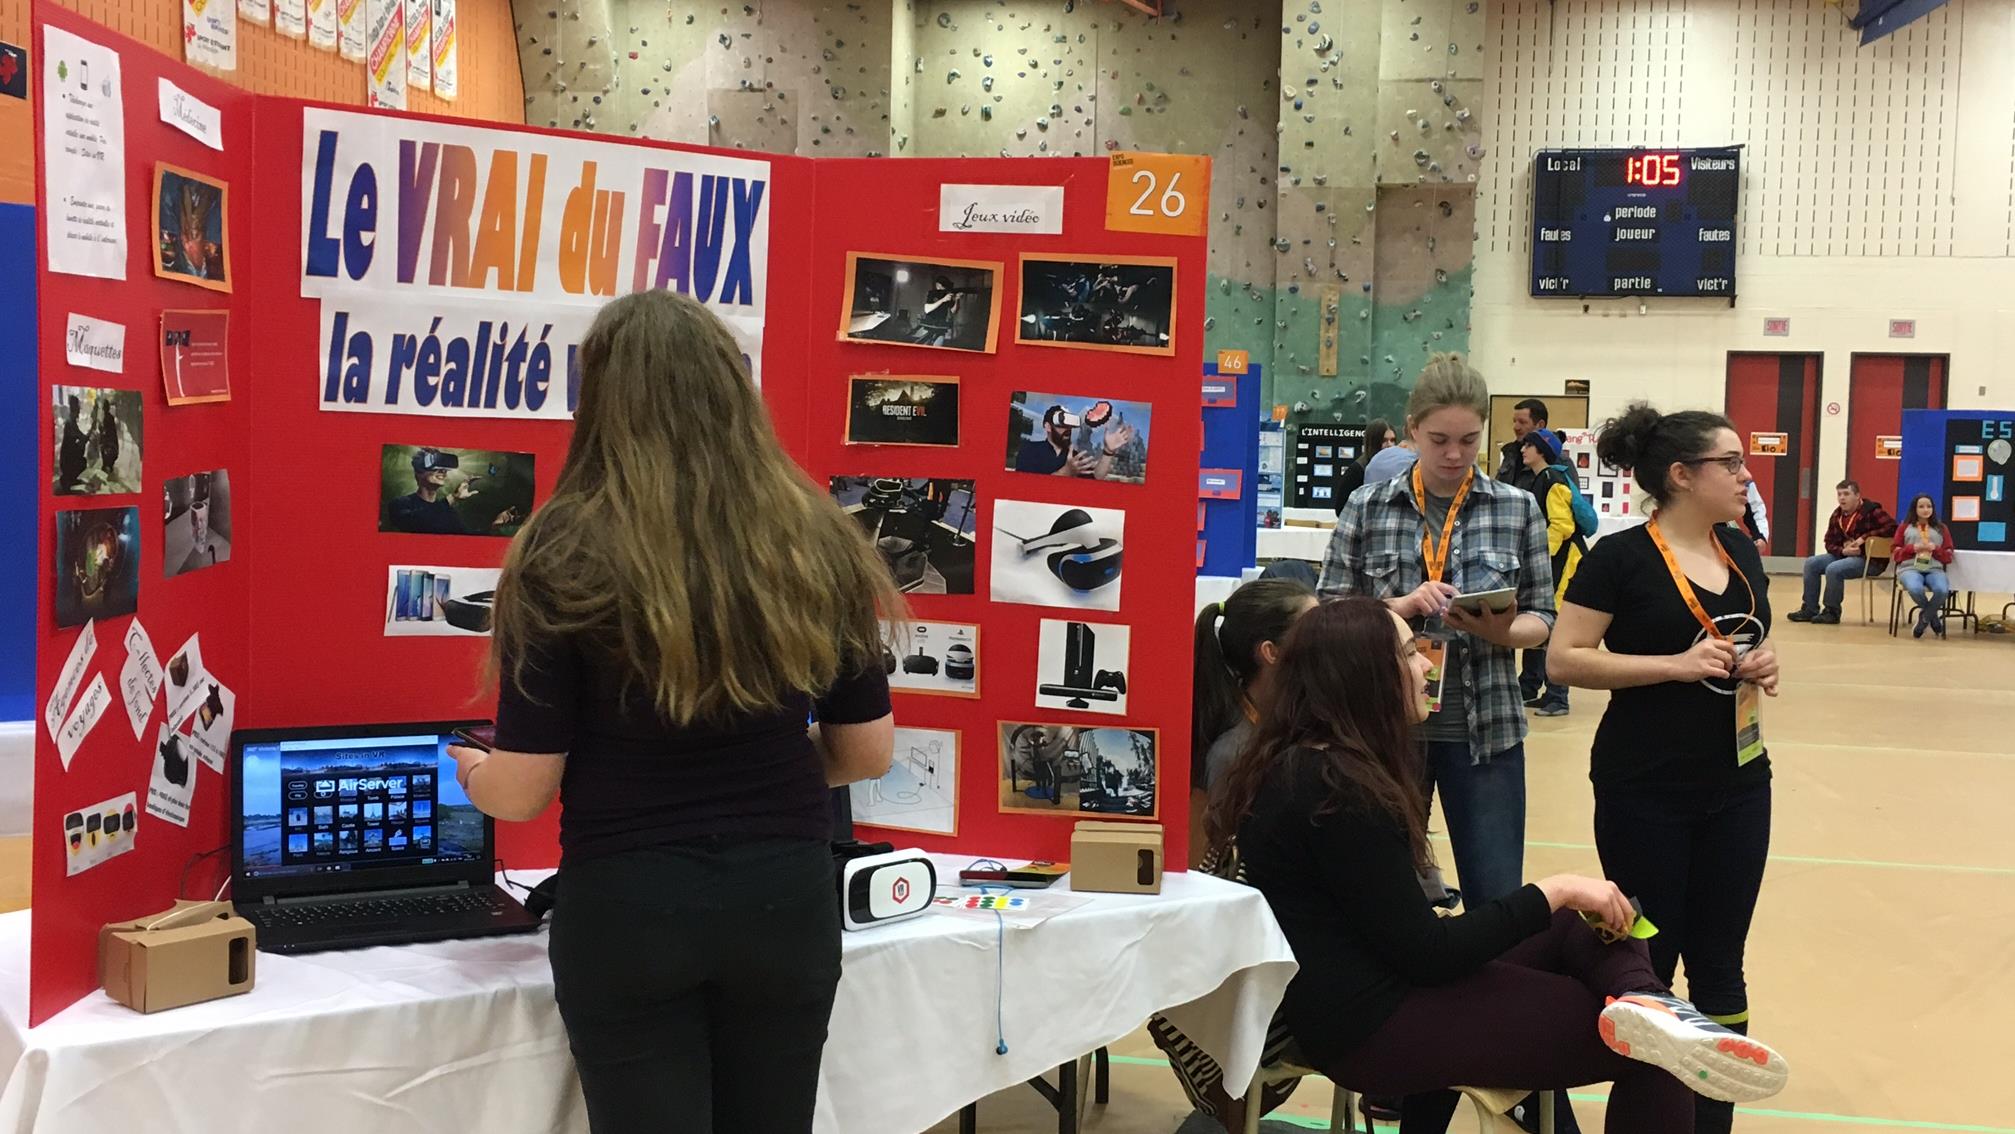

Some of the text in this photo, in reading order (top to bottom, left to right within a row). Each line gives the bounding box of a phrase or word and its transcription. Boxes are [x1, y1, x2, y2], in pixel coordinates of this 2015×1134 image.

[1547, 157, 1580, 171] Local
[1626, 154, 1680, 185] 1:05
[1691, 157, 1735, 171] Visiteurs
[1130, 170, 1185, 217] 26
[306, 129, 766, 306] Le VRAI du FAUX
[952, 202, 1040, 230] Jeux vidéo
[1540, 227, 1571, 241] fautes
[1614, 227, 1656, 241] joueur
[1699, 227, 1731, 241] fautes
[1614, 276, 1652, 291] partie
[1697, 277, 1729, 291] vict'r
[68, 324, 122, 364] Maquettes
[324, 311, 374, 404] la
[384, 316, 554, 412] réalité
[1224, 354, 1242, 369] 46
[882, 405, 912, 416] RESIDENT
[1301, 427, 1366, 437] L'INTELLIGENC
[338, 778, 403, 791] AirServer
